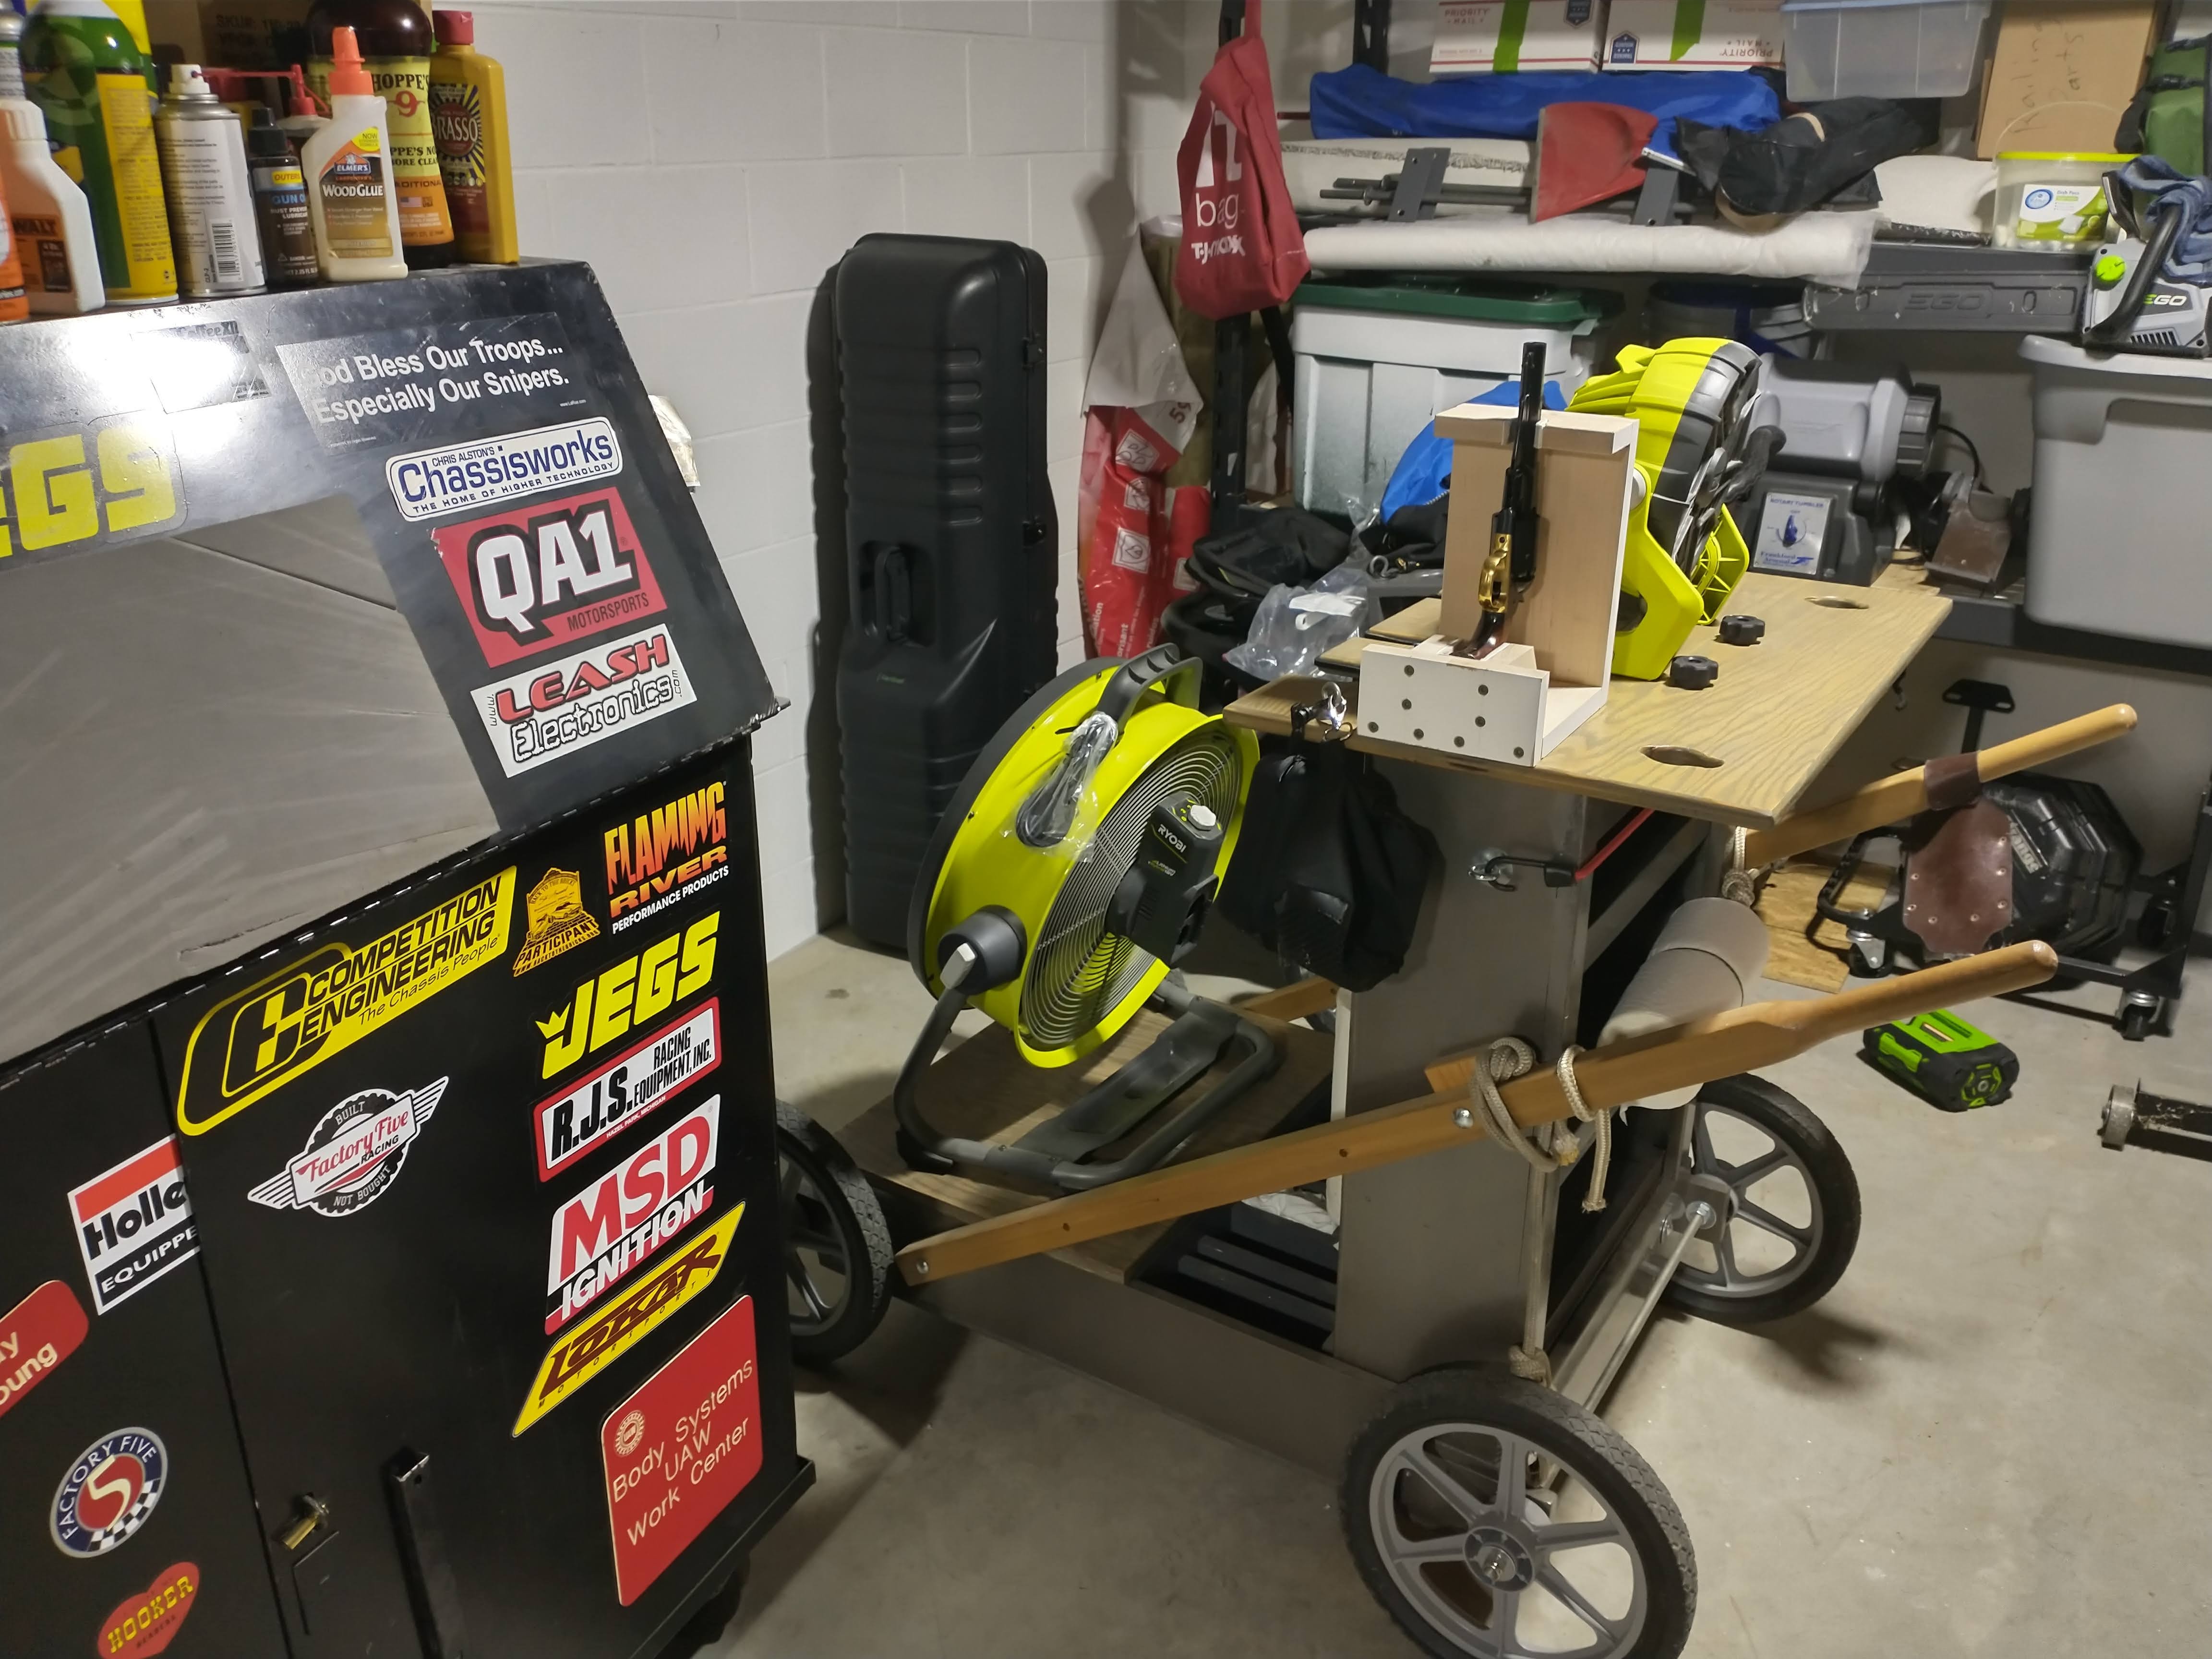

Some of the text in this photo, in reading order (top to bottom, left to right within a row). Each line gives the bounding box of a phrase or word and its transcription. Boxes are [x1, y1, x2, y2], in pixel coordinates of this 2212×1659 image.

[1444, 8, 1488, 17] PRIORITY
[1721, 48, 1773, 58] PRIORITY
[395, 90, 418, 118] 9
[272, 194, 297, 204] GUN
[337, 164, 369, 172] ELMER'S
[1196, 192, 1239, 229] bag
[1906, 293, 1984, 311] EGO
[2142, 293, 2187, 306] EGO
[356, 353, 424, 382] Bless
[425, 343, 468, 370] Our
[469, 336, 564, 365] Troops...
[312, 366, 570, 426] Especially Our Snipers.
[397, 429, 613, 503] Chassisworks
[412, 461, 614, 514] THE HOME OF HIGHER TECHNOLOGY
[432, 447, 495, 468] CHRIS ALSTON'S
[0, 425, 176, 558] GS
[476, 511, 633, 633] QA1
[566, 592, 650, 632] MOTORSPORTS
[496, 634, 670, 724] LEASH
[510, 675, 673, 763] Electronics
[604, 781, 727, 896] FLAMING
[1157, 823, 1187, 853] RYOBI
[529, 891, 542, 904] BACK
[610, 845, 728, 918] RIVER
[612, 865, 729, 935] PERFORMANCE PRODUCTS
[307, 875, 502, 1007] COMPETITION
[515, 919, 598, 969] PARTICIPANT
[301, 910, 496, 1044] ENGINEERING
[359, 936, 498, 1025] The Chassis People
[535, 910, 720, 1080] JEGS
[653, 1026, 692, 1070] RACING
[693, 1038, 712, 1069] INC.
[335, 1101, 366, 1126] BUILT
[551, 1066, 633, 1162] R.J.S.
[606, 1095, 667, 1139] HAZEL PARK, MICHIGAN
[295, 1110, 409, 1183] Factory Five
[360, 1134, 400, 1165] RACING
[333, 1166, 391, 1206] NOT BOUGHT
[559, 1115, 711, 1284] MSD
[101, 1224, 199, 1294] EQUIPPE
[561, 1178, 706, 1322] IGNITION
[0, 1331, 19, 1364] y
[538, 1268, 711, 1409] MOTORSPORTS
[539, 1234, 722, 1401] LOKAR
[612, 1358, 754, 1504] Body Systems
[664, 1420, 712, 1483] UAW
[57, 1435, 157, 1540] FACTORY FIVE
[626, 1417, 749, 1547] Work Center
[107, 1575, 194, 1654] HOOKER
